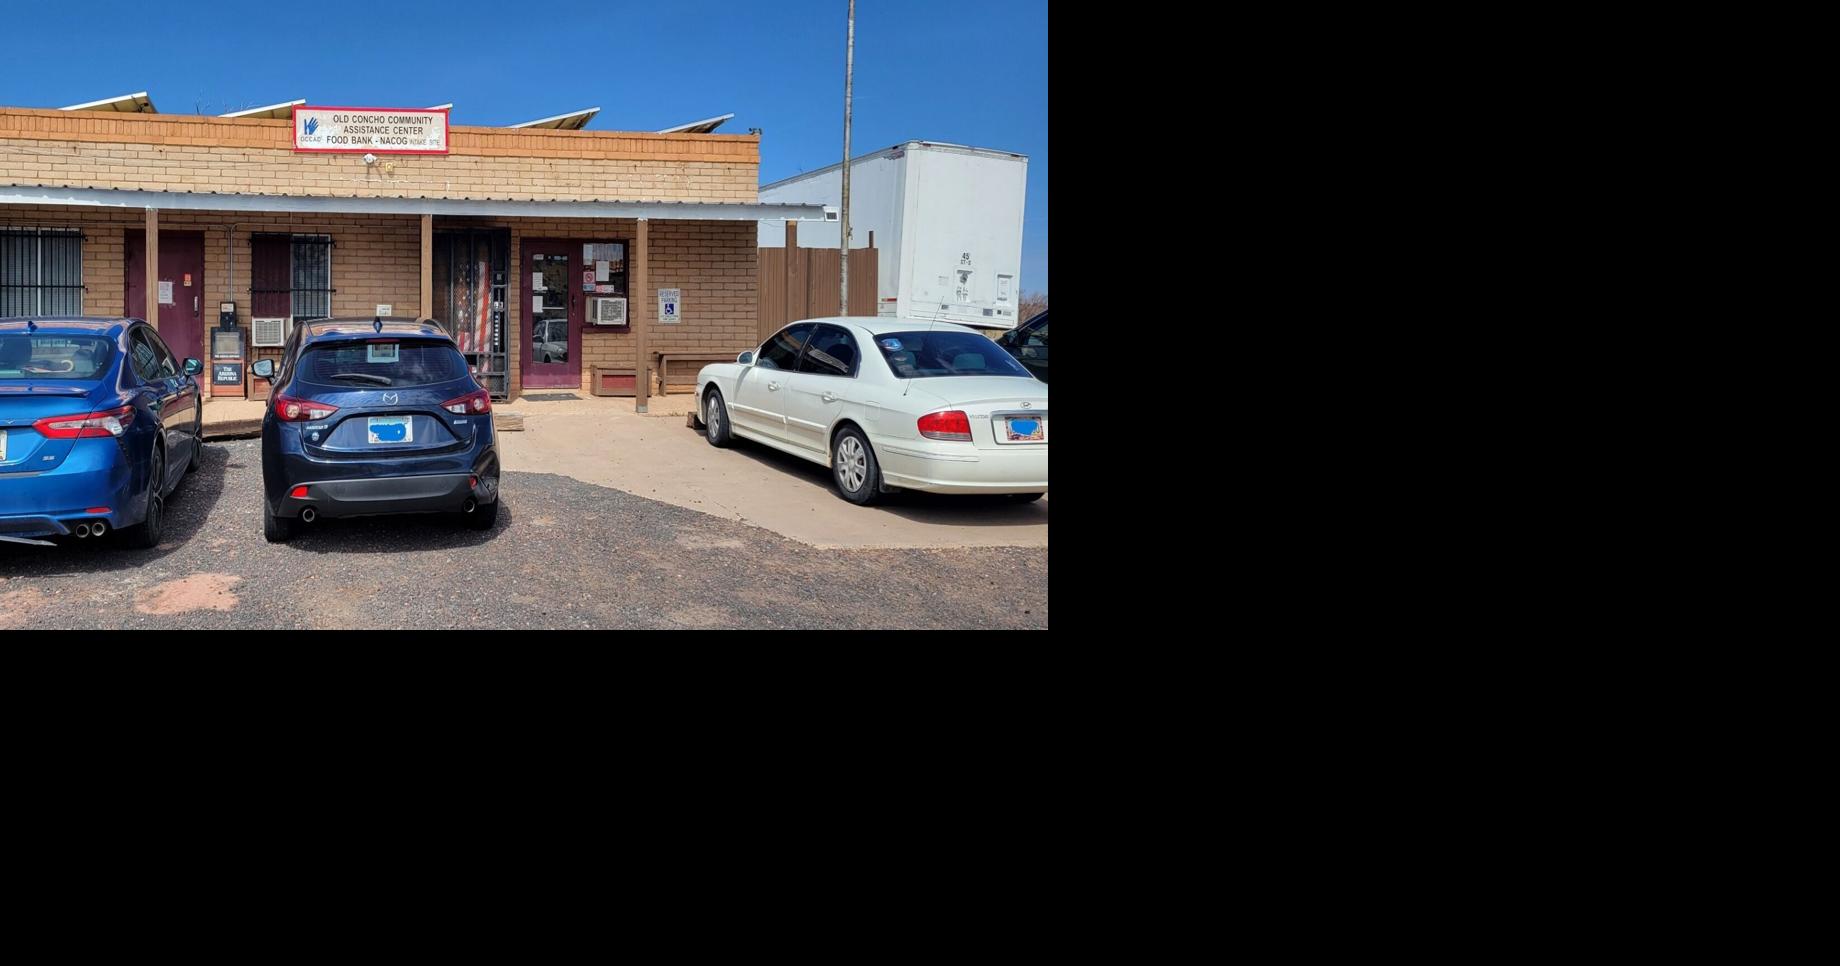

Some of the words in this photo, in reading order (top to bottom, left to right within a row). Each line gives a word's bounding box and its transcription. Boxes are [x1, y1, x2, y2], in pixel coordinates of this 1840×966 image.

[333, 114, 349, 123] OLD
[352, 115, 385, 124] CONCHO
[388, 115, 433, 125] COMMUNITY
[343, 125, 390, 135] ASSISTANCE
[393, 126, 424, 135] CENTER
[326, 135, 348, 144] FOOD
[351, 136, 373, 145] BANK
[380, 136, 408, 145] NACOG
